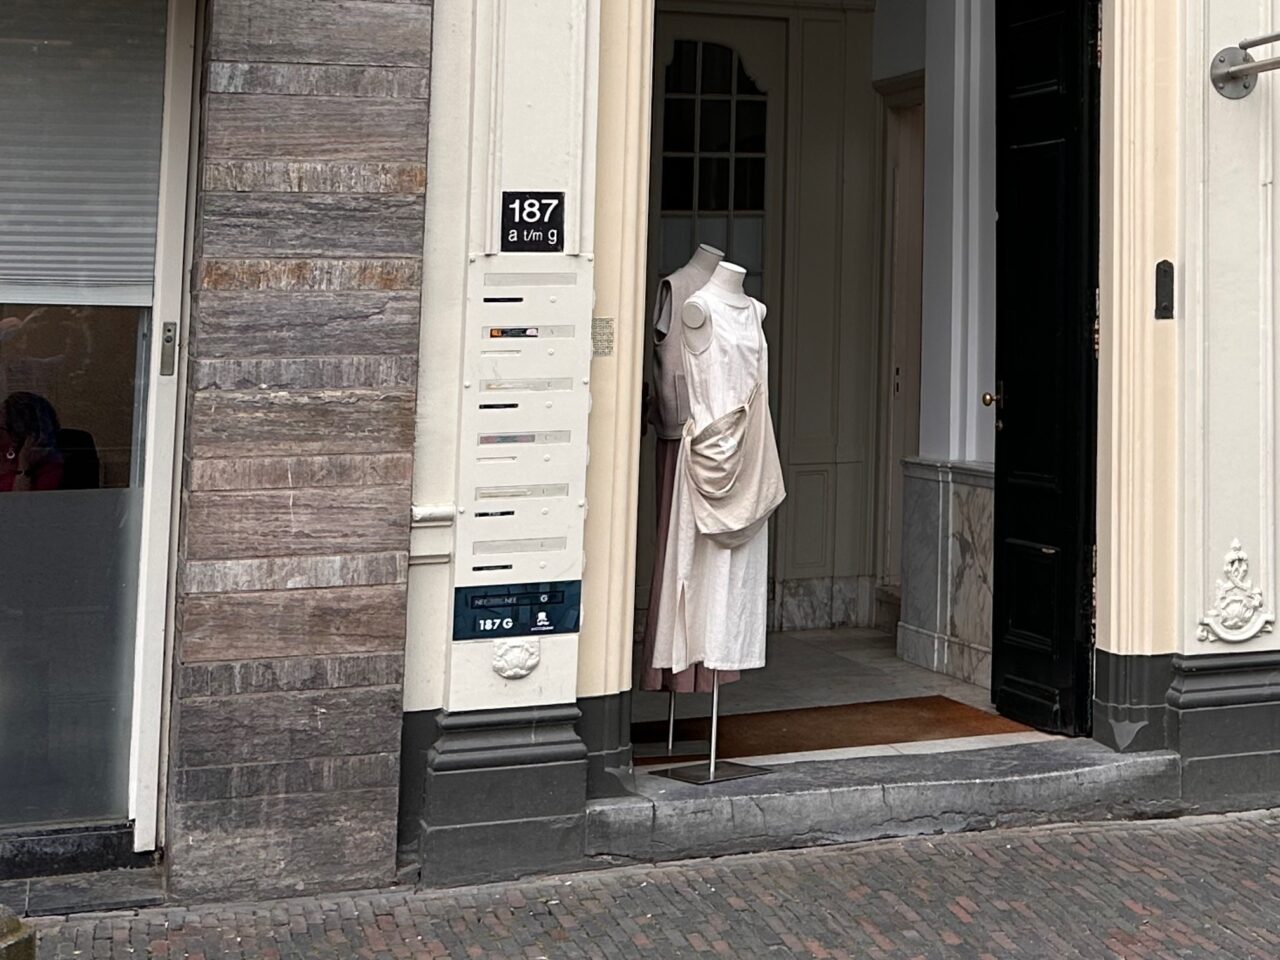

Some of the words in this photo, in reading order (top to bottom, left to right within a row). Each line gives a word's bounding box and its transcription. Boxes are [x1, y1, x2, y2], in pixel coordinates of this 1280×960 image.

[509, 199, 559, 222] 187
[508, 229, 518, 242] a
[523, 229, 543, 241] t/m
[548, 229, 558, 244] g
[540, 594, 548, 602] G
[479, 619, 501, 631] 187
[502, 618, 514, 629] G
